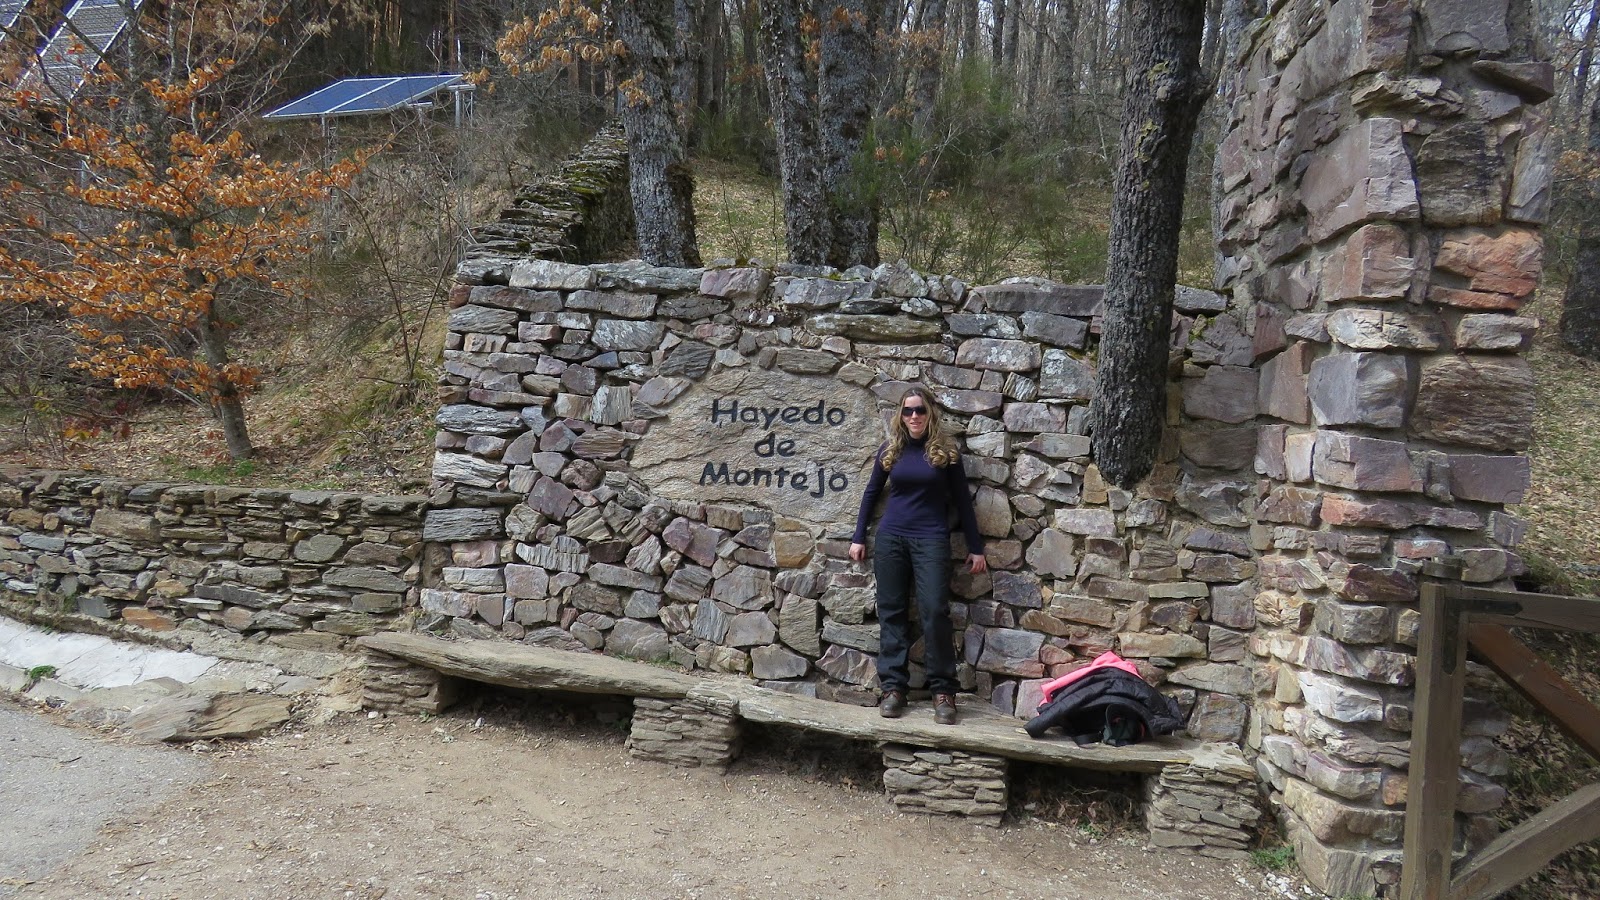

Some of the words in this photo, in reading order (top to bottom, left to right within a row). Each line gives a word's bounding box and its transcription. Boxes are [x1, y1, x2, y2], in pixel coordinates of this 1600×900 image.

[711, 399, 845, 430] Hayedo
[754, 431, 796, 458] de
[700, 461, 848, 498] Montejo
